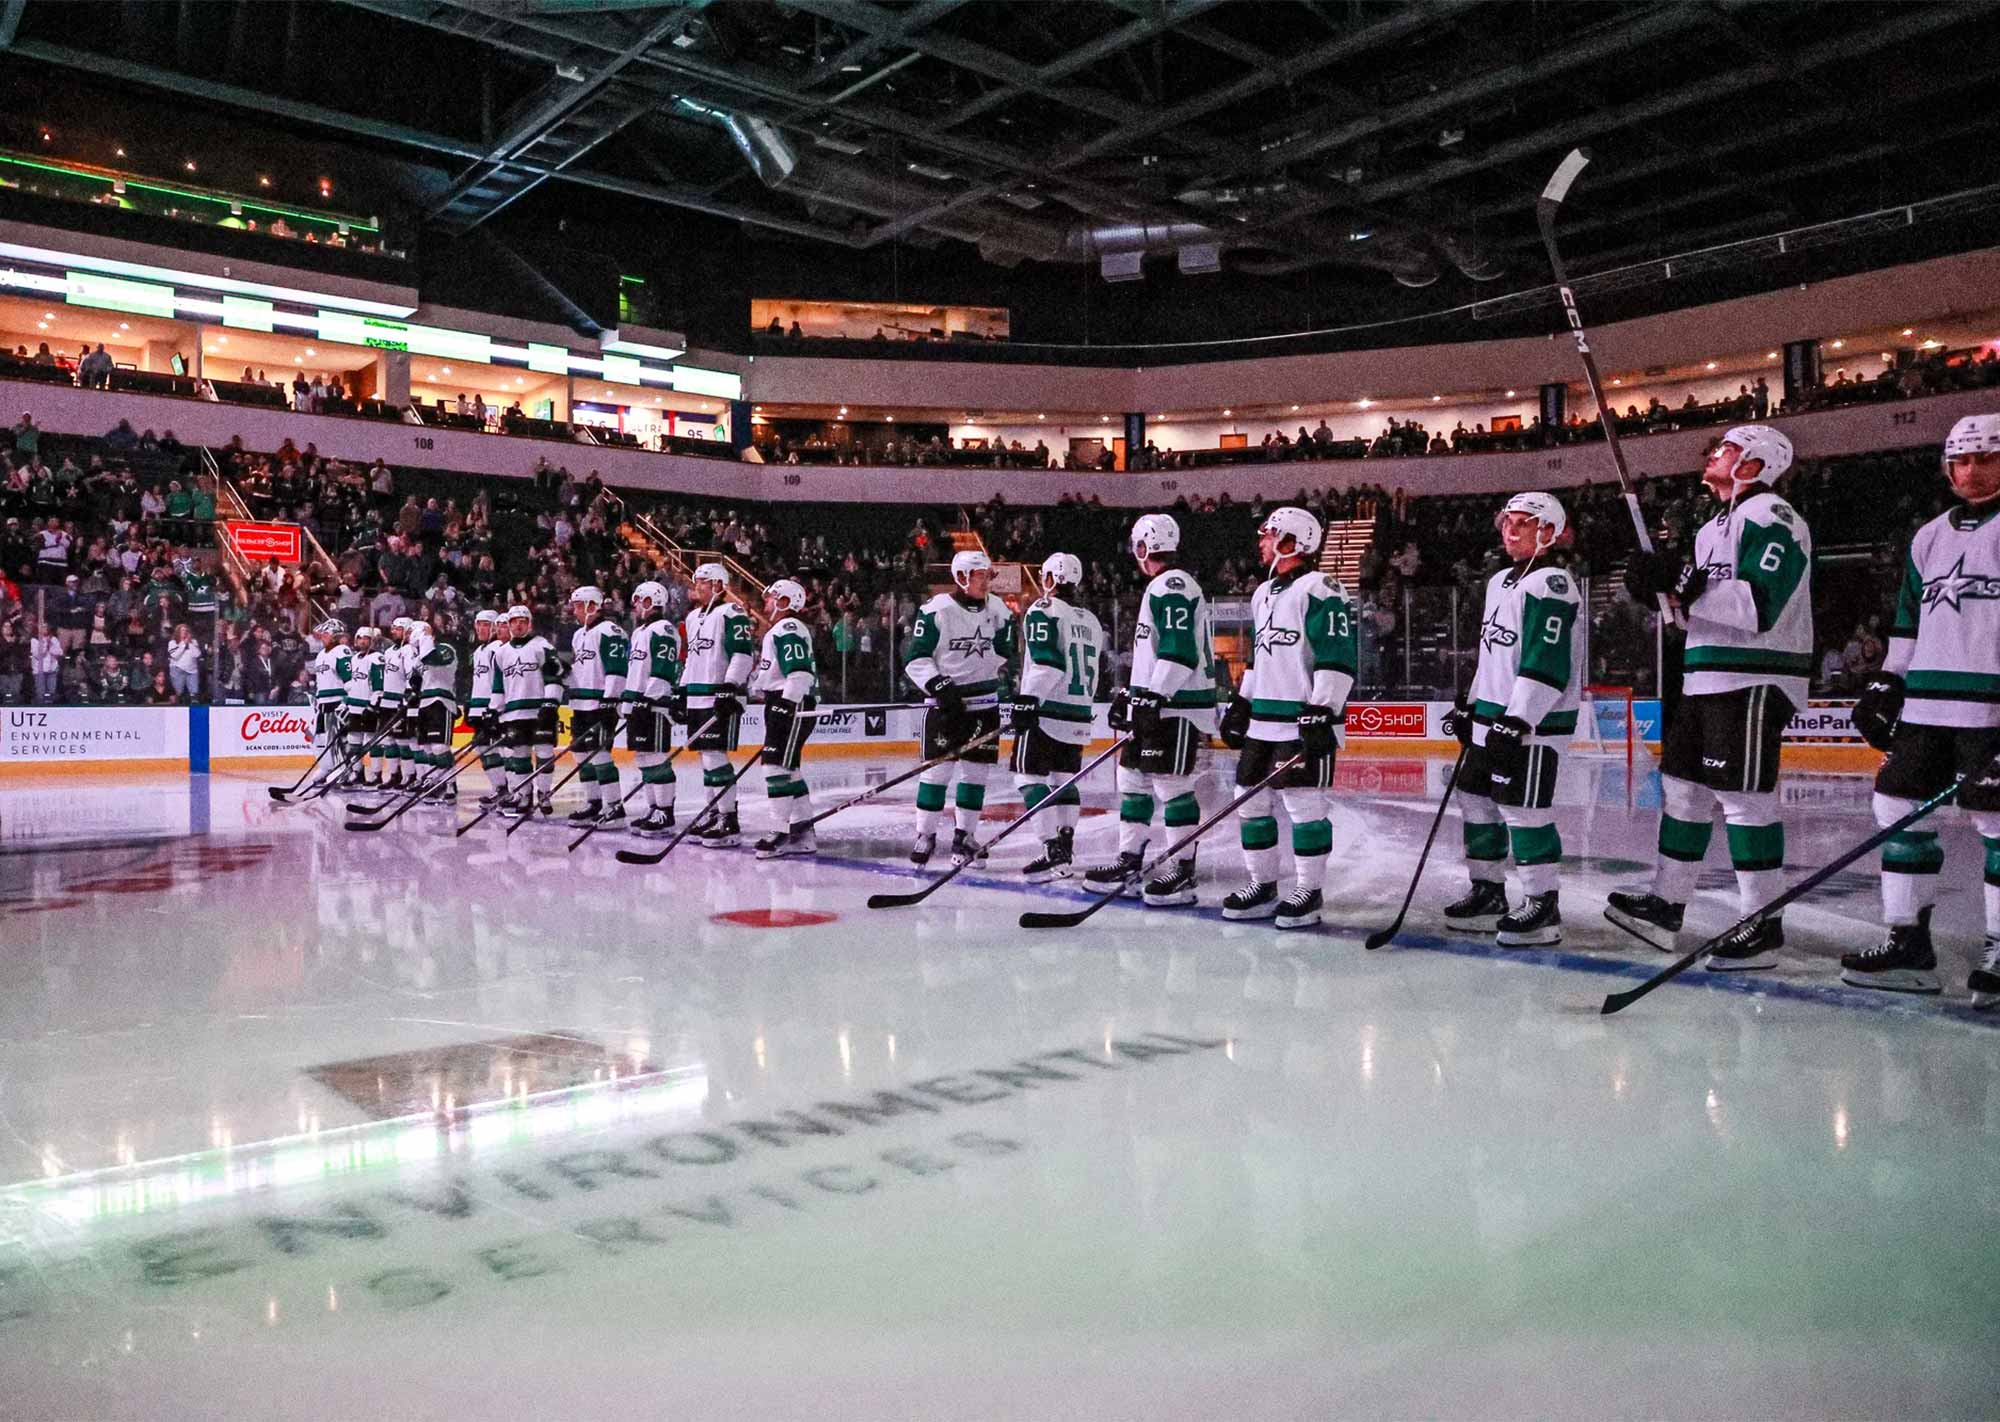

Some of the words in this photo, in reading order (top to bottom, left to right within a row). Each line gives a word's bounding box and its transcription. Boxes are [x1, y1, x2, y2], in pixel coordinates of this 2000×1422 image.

[1560, 287, 1590, 353] CCM
[414, 437, 433, 450] 108
[784, 474, 800, 486] 109
[1161, 480, 1177, 490] 110
[1760, 542, 1785, 572] 6
[1164, 606, 1188, 630] 12
[1327, 611, 1349, 637] 13
[913, 619, 925, 637] 6
[1028, 622, 1048, 641] 15
[1543, 616, 1562, 644] 9
[657, 644, 677, 662] 26
[783, 644, 805, 661] 20
[1068, 642, 1097, 697] 15
[11, 711, 47, 727] UTZ
[241, 712, 307, 741] Cedar
[818, 714, 852, 725] ORY
[1384, 714, 1422, 726] SHOP
[11, 731, 141, 741] ENVIRONMENTAL
[11, 745, 86, 755] SERVICES
